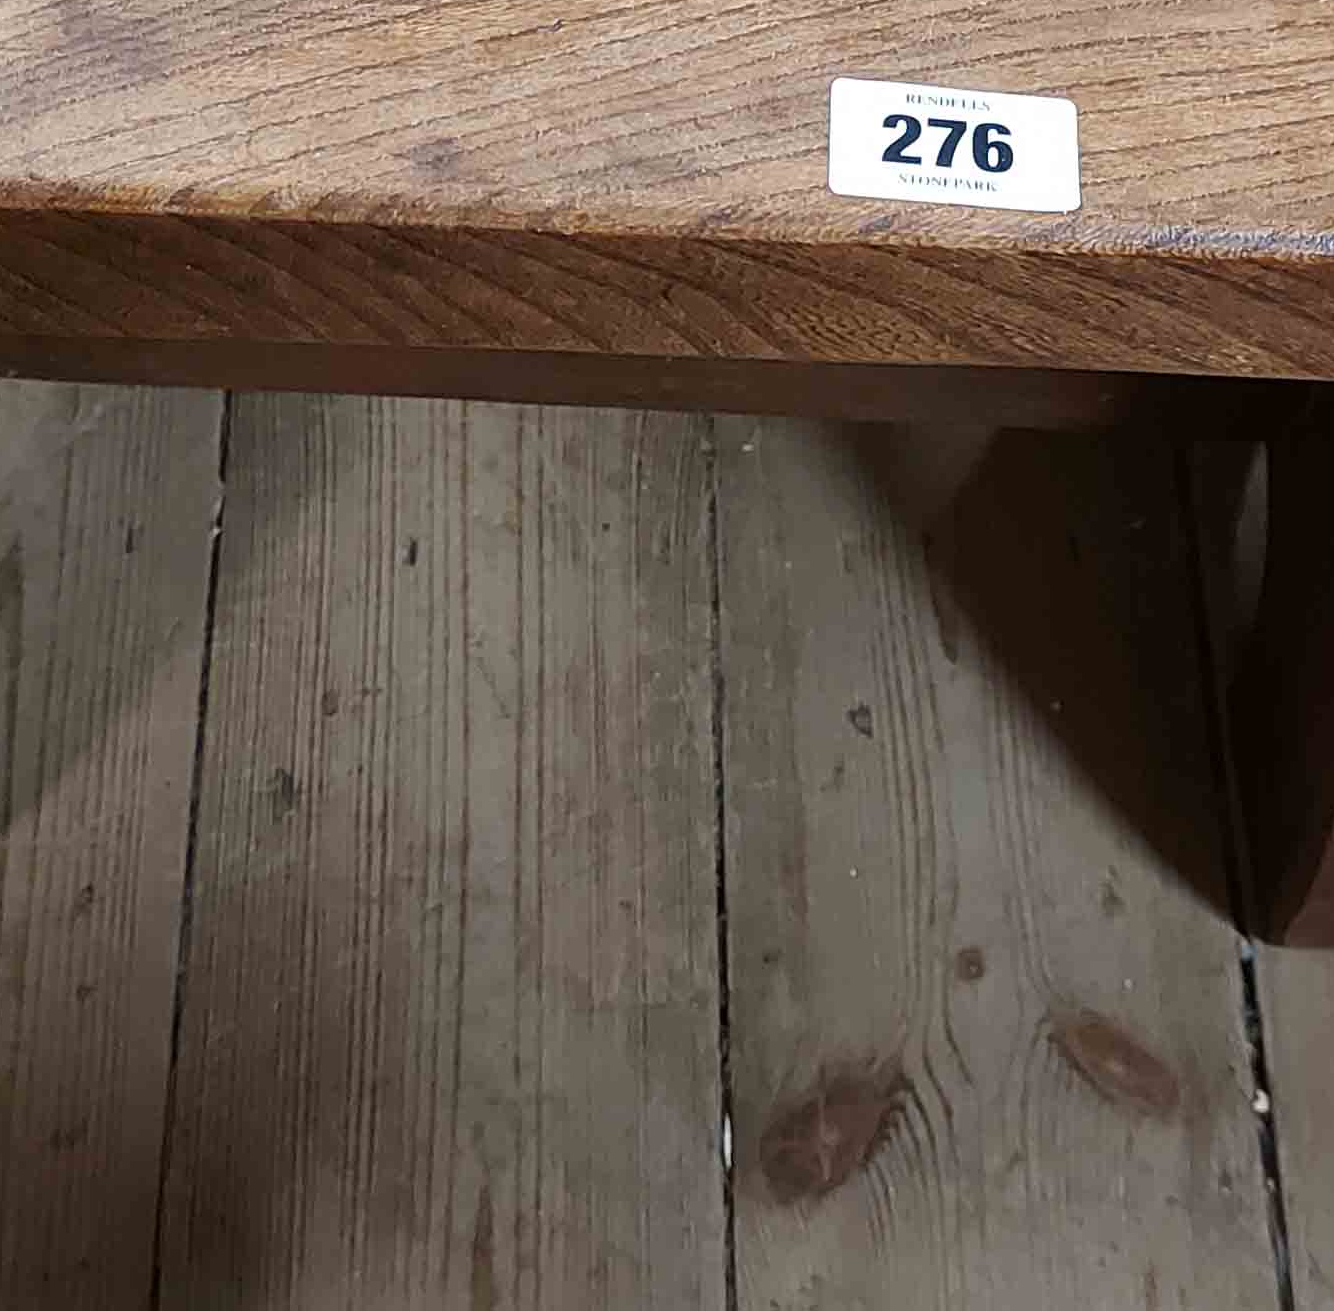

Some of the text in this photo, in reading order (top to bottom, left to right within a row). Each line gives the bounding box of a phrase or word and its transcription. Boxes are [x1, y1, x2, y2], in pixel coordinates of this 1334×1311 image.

[905, 93, 991, 111] RENDELLS
[881, 114, 1014, 173] 276
[898, 173, 999, 192] STONEPARK
